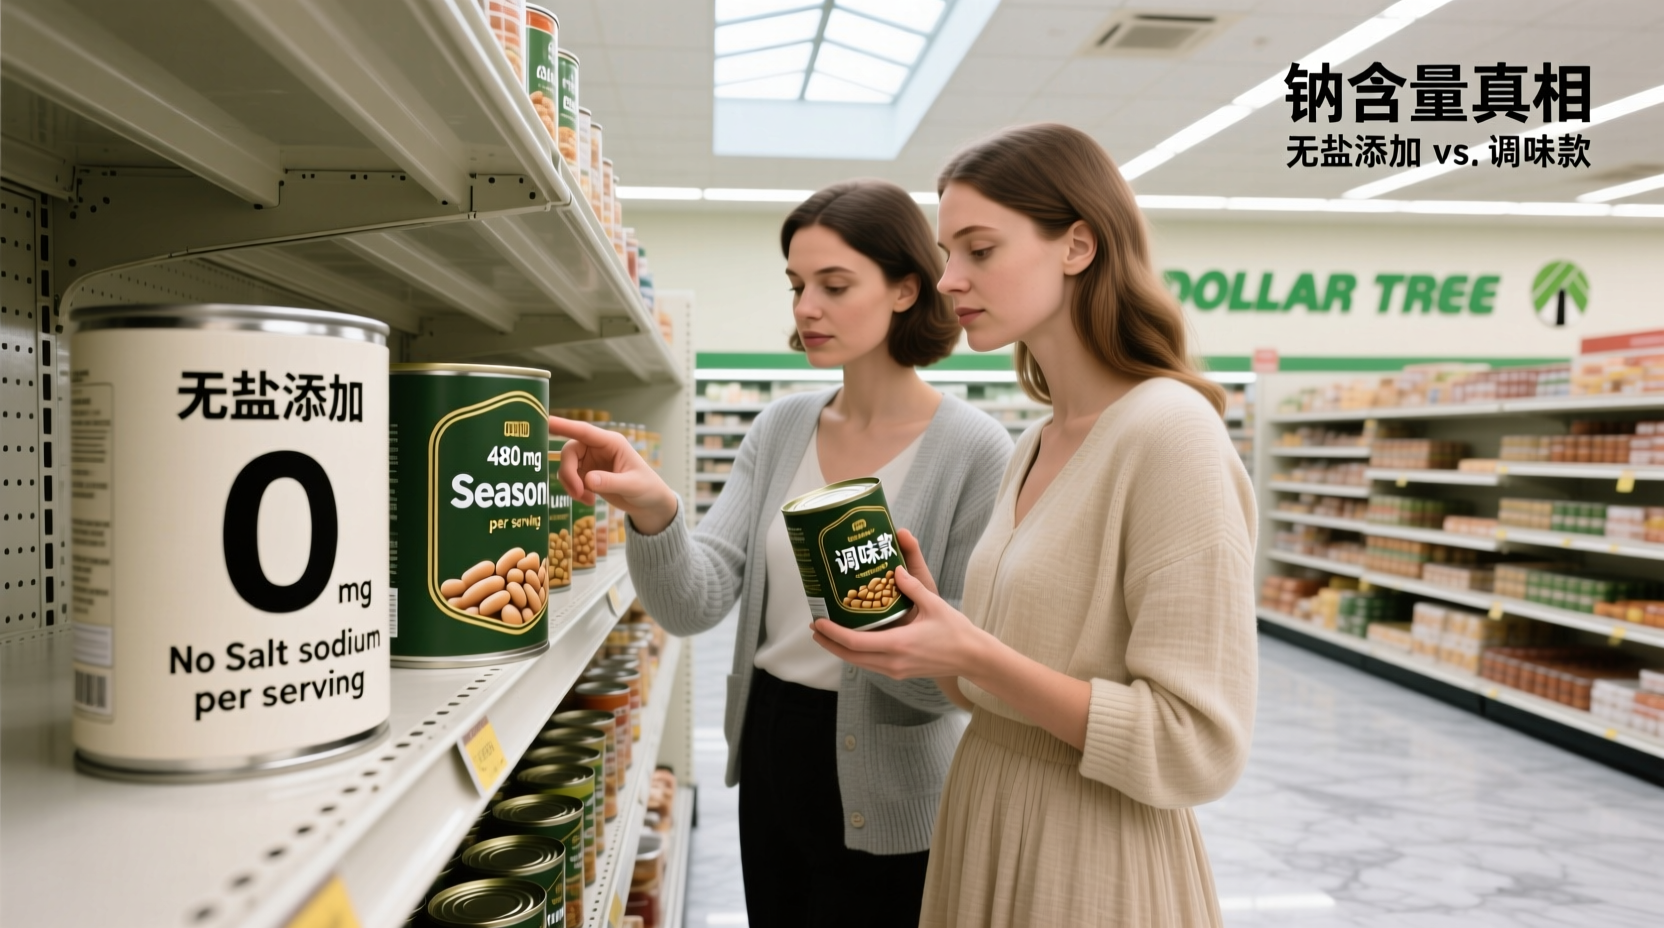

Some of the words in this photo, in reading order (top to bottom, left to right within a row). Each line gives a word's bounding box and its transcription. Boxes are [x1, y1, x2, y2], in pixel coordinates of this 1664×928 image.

[1374, 274, 1501, 314] TREE
[177, 370, 364, 423] 无盐添加
[486, 445, 521, 467] 480
[522, 451, 542, 473] mg
[222, 449, 339, 614] 0
[488, 518, 509, 534] per
[835, 533, 897, 574] 调味款
[338, 579, 372, 609] mg
[169, 645, 215, 675] No
[226, 638, 289, 672] Salt
[299, 627, 380, 664] sodium
[194, 687, 252, 722] per
[261, 668, 364, 707] serving
